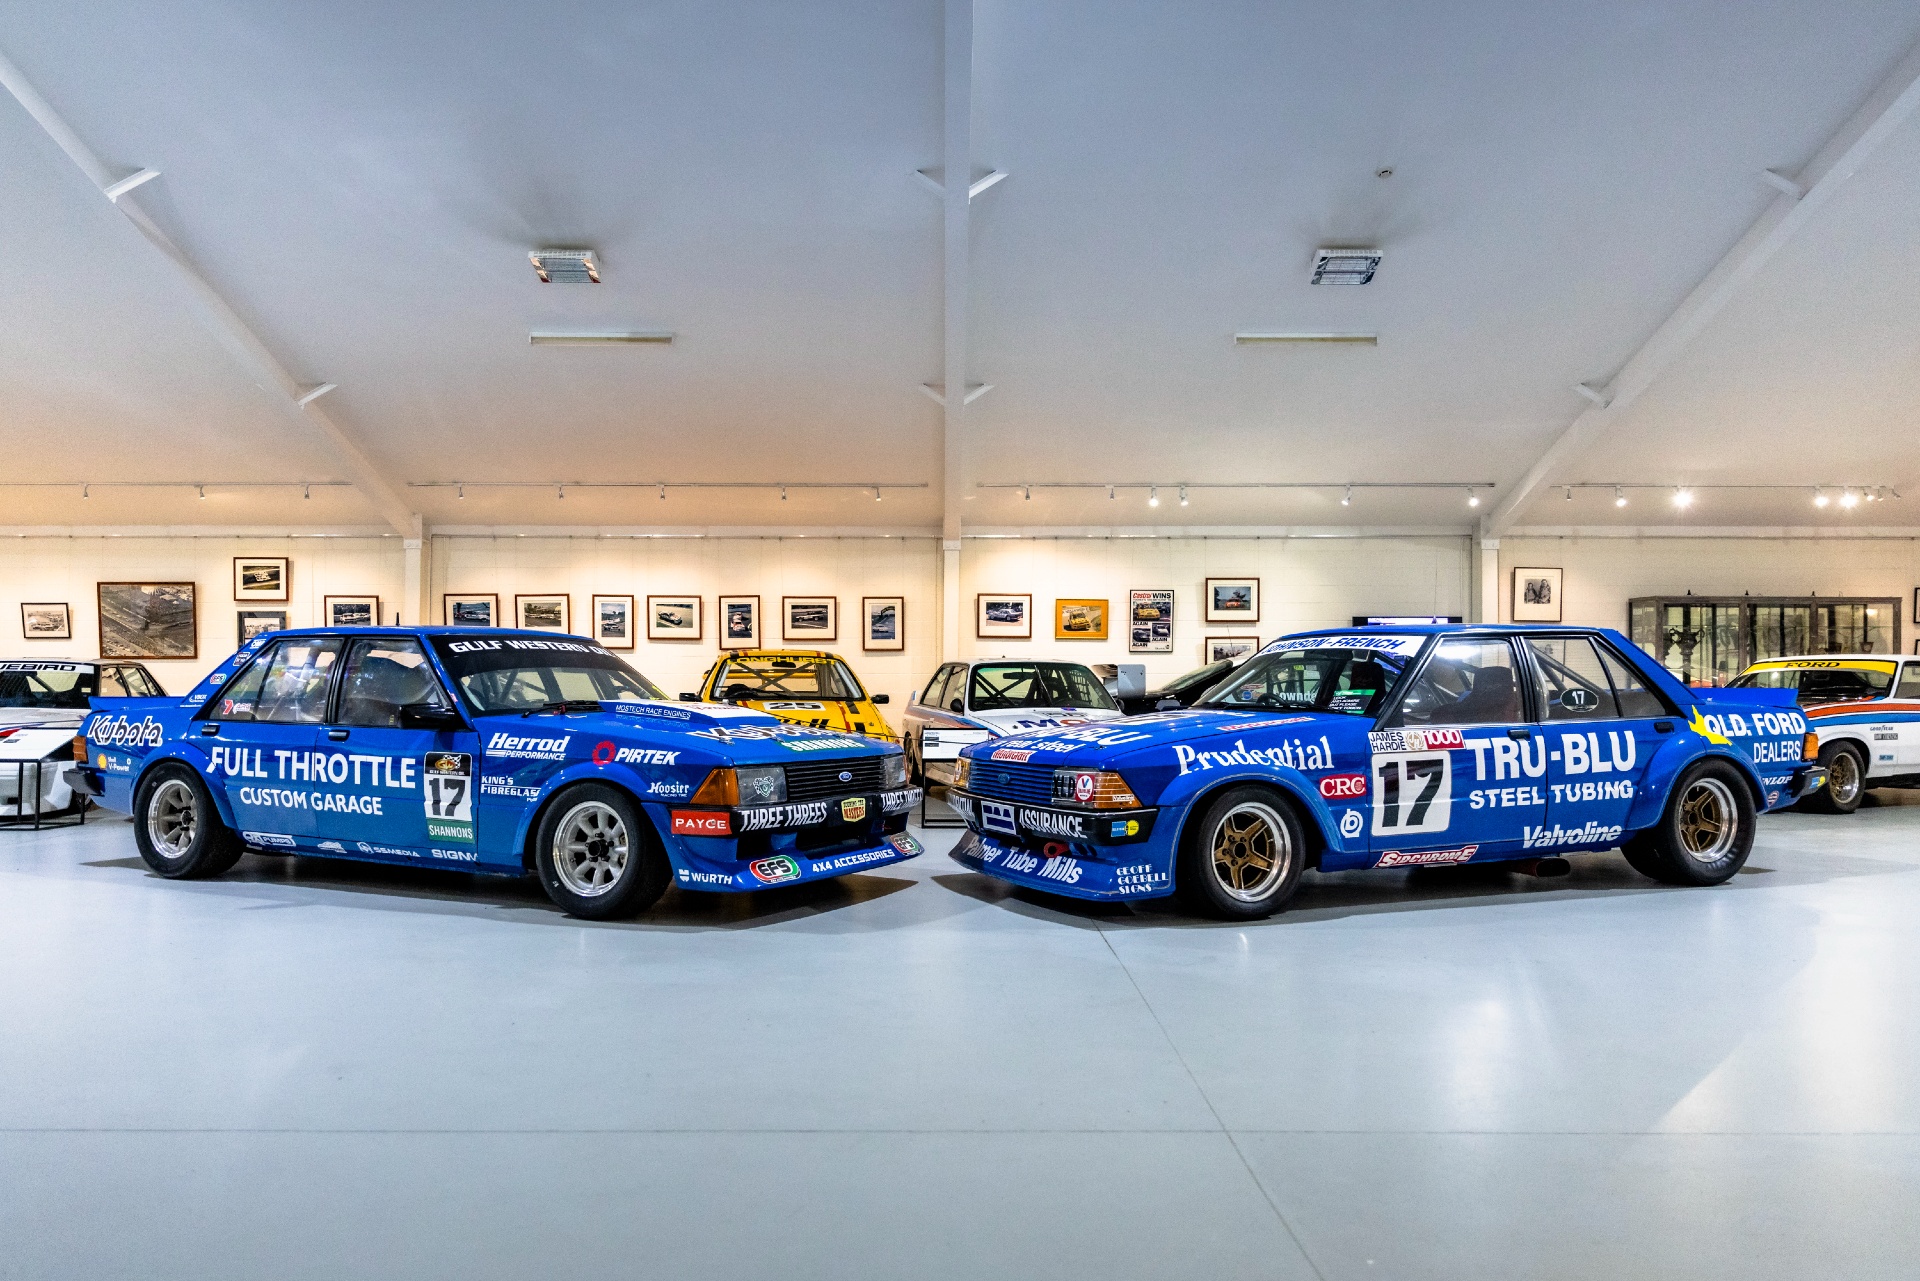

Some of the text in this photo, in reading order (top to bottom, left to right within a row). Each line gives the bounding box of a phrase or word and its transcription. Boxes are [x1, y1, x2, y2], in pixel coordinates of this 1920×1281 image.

[448, 640, 502, 653] GULF
[503, 640, 590, 653] WESTERN
[727, 656, 836, 665] LONGHURST
[1784, 661, 1841, 669] FORD
[769, 702, 821, 710] 25
[1571, 690, 1585, 705] 17
[615, 704, 691, 719] MOSTECH RACE ENGINES
[87, 715, 163, 746] Kubota
[1703, 712, 1806, 738] QLD. FORD
[487, 732, 571, 753] Herrod
[1370, 731, 1404, 743] JAMES
[1424, 729, 1461, 746] 1000
[505, 749, 567, 761] PERFORMANCE
[1372, 741, 1407, 752] HARDIE
[1465, 730, 1637, 781] TRU-BLU
[1753, 740, 1801, 763] DEALERS
[615, 747, 681, 765] PIRTEK
[1172, 735, 1335, 777] Prudential
[108, 763, 130, 771] V-Power
[206, 746, 416, 789] FULL THROTTLE
[481, 775, 514, 786] KING'S
[646, 780, 690, 794] Hoosier
[1319, 776, 1366, 797] CRC
[240, 787, 384, 815] CUSTOM GARAGE
[428, 778, 466, 817] 17
[1378, 758, 1444, 828] 17
[1469, 779, 1634, 810] STEEL TUBING
[739, 801, 828, 832] THREE THREES
[1019, 808, 1088, 839] ASSURANCE
[428, 824, 473, 839] SHANNONS
[1523, 821, 1623, 849] Valvoline
[812, 848, 896, 873] 4X4 ACCESSORIES
[962, 834, 1084, 884] Palmer Tube Mills
[1378, 848, 1475, 868] SIDCHROME
[757, 859, 792, 877] EFS
[1116, 863, 1153, 876] GEOFF
[1117, 872, 1169, 885] GOEBELL
[1118, 883, 1152, 895] SIGNS
